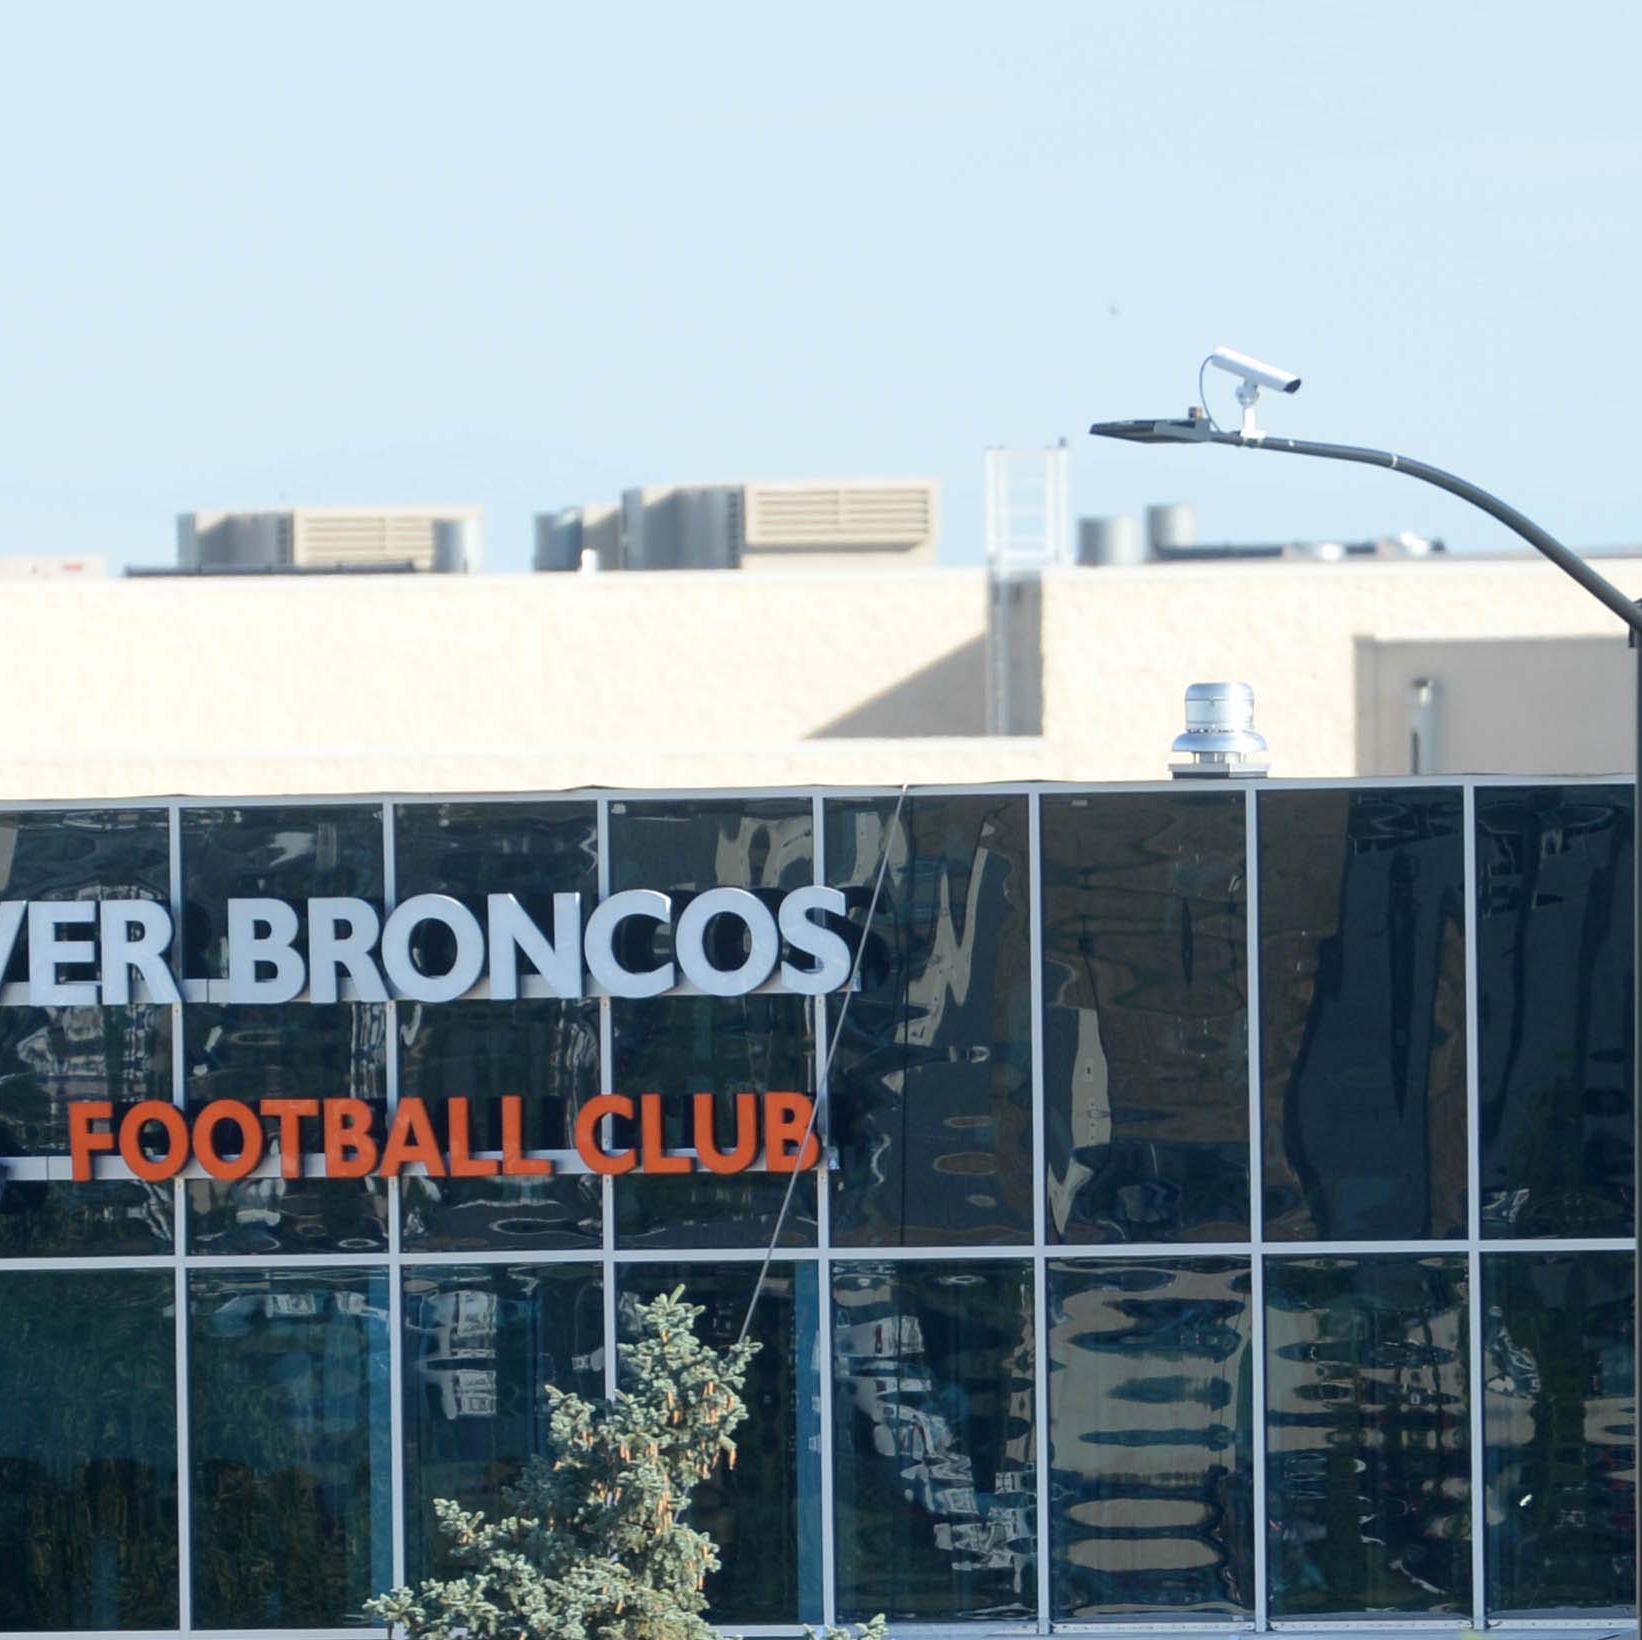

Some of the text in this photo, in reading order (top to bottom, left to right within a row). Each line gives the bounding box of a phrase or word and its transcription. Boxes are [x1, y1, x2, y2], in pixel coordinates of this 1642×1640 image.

[226, 885, 855, 1005] BRONCOS
[68, 1090, 824, 1183] FOOTBALL CLUB
